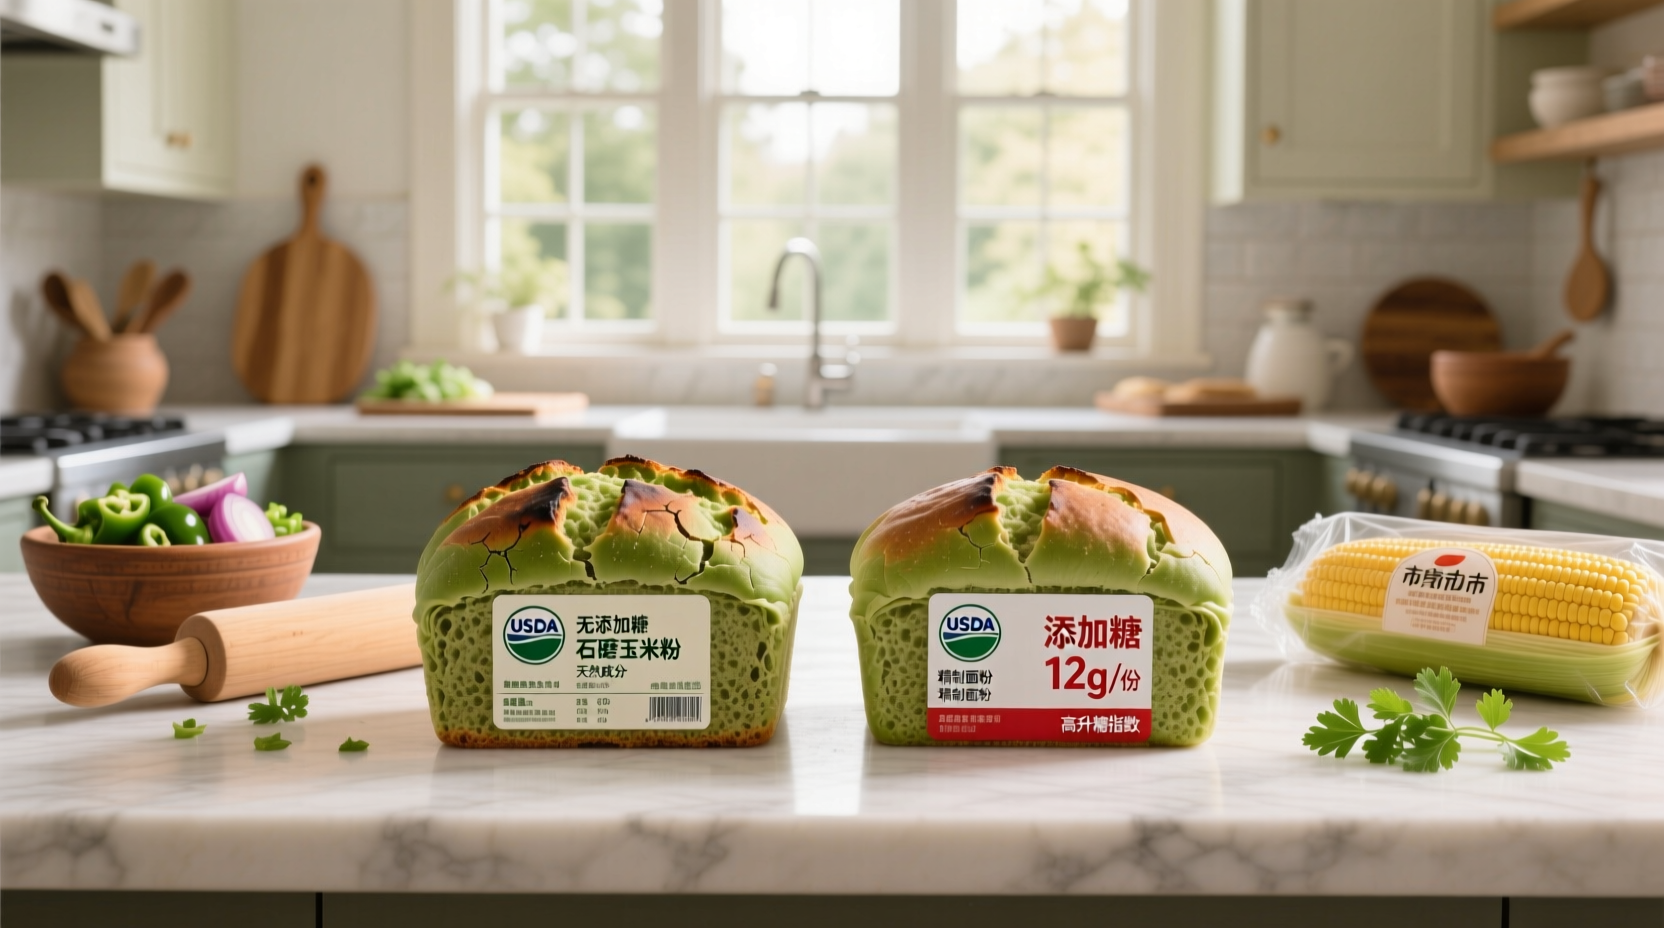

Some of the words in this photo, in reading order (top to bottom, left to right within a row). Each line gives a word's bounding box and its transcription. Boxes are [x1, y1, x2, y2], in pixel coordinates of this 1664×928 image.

[510, 618, 559, 633] USDA
[576, 614, 649, 634] 无添加糖
[946, 616, 995, 632] USDA
[1043, 614, 1143, 650] 添加糖
[1045, 656, 1141, 700] 12g/份
